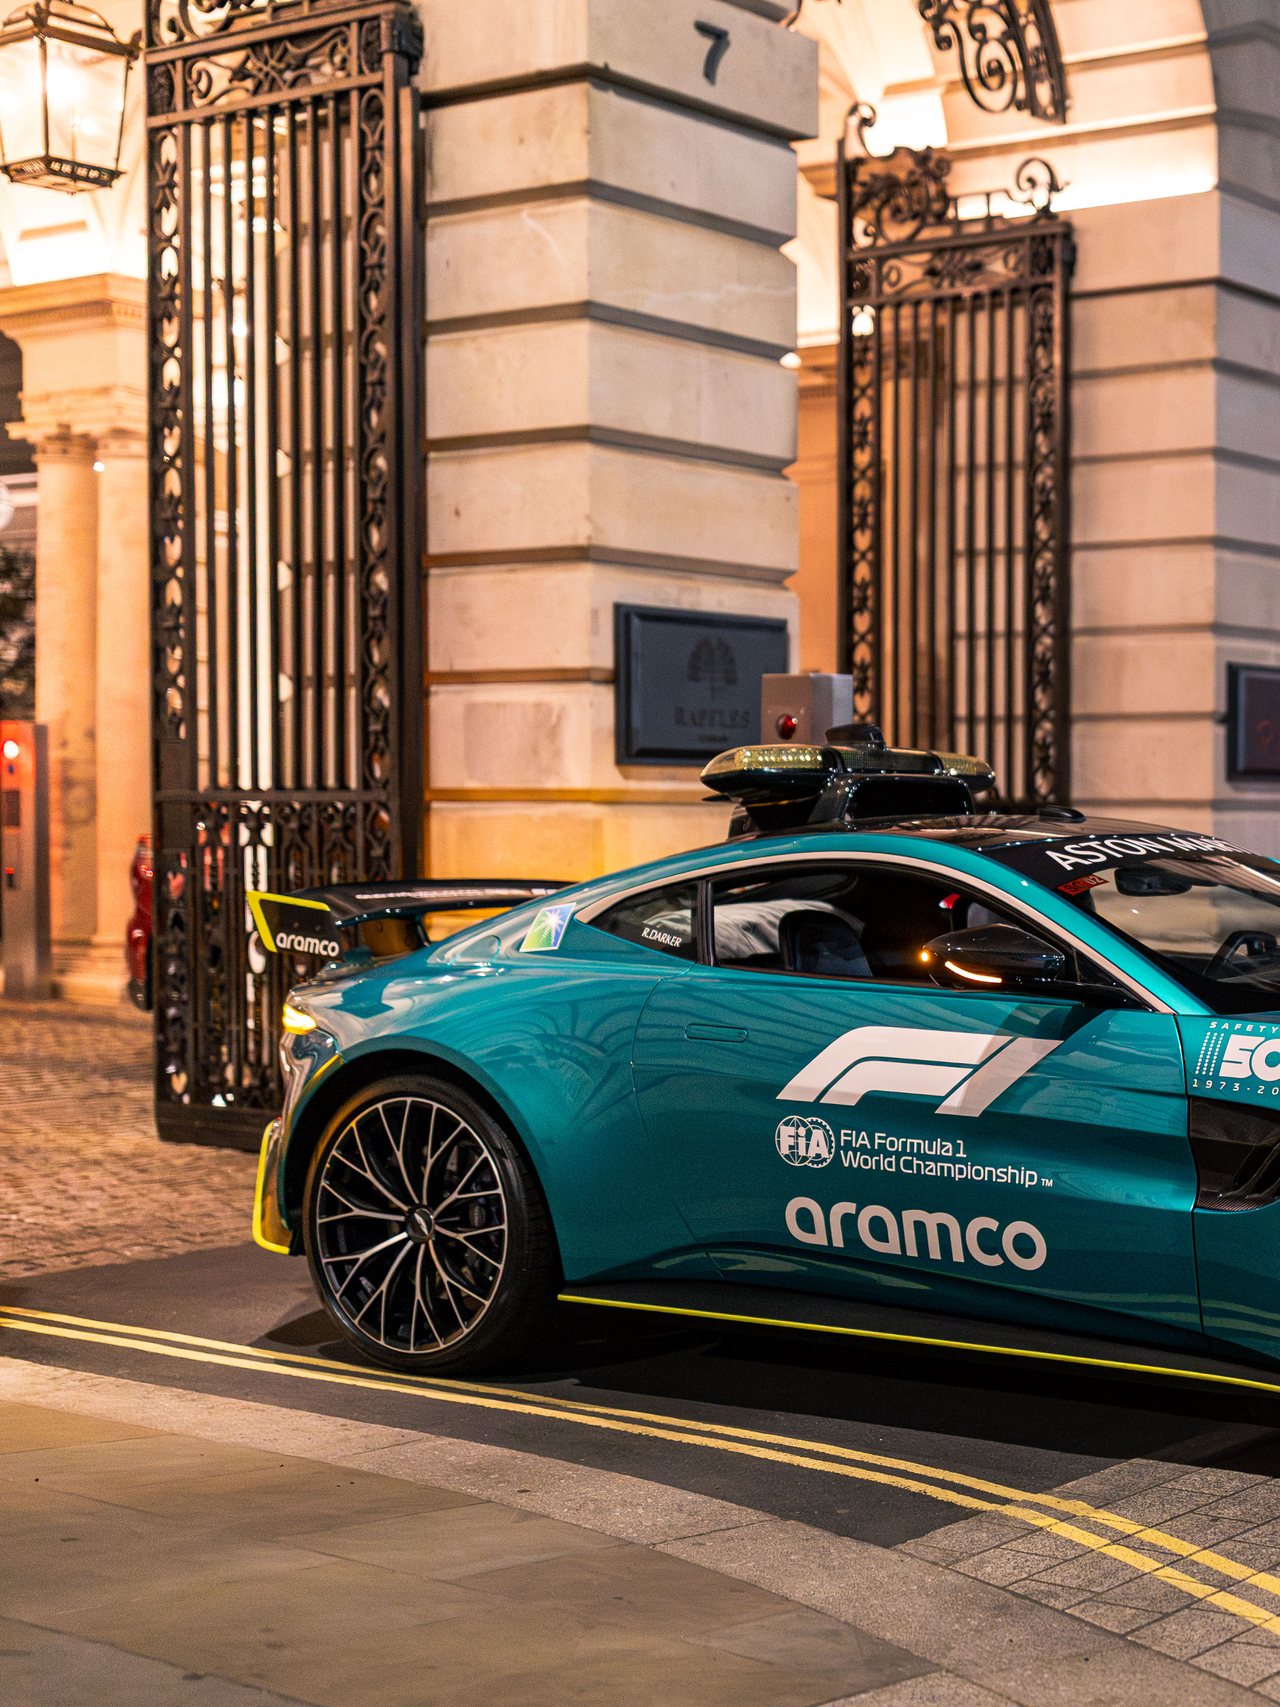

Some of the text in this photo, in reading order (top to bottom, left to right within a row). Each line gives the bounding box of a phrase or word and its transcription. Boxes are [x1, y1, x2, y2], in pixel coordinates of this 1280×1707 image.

[694, 20, 731, 87] 7
[1045, 837, 1175, 871] ASTON
[1063, 876, 1104, 892] SC 02
[275, 932, 340, 957] aramco
[641, 927, 682, 948] R.DARKER
[1209, 1021, 1279, 1034] SAFETY
[840, 1129, 967, 1158] FIA Formula 1
[839, 1149, 896, 1172] World
[900, 1156, 1038, 1188] Championship
[785, 1196, 1047, 1271] aramco
